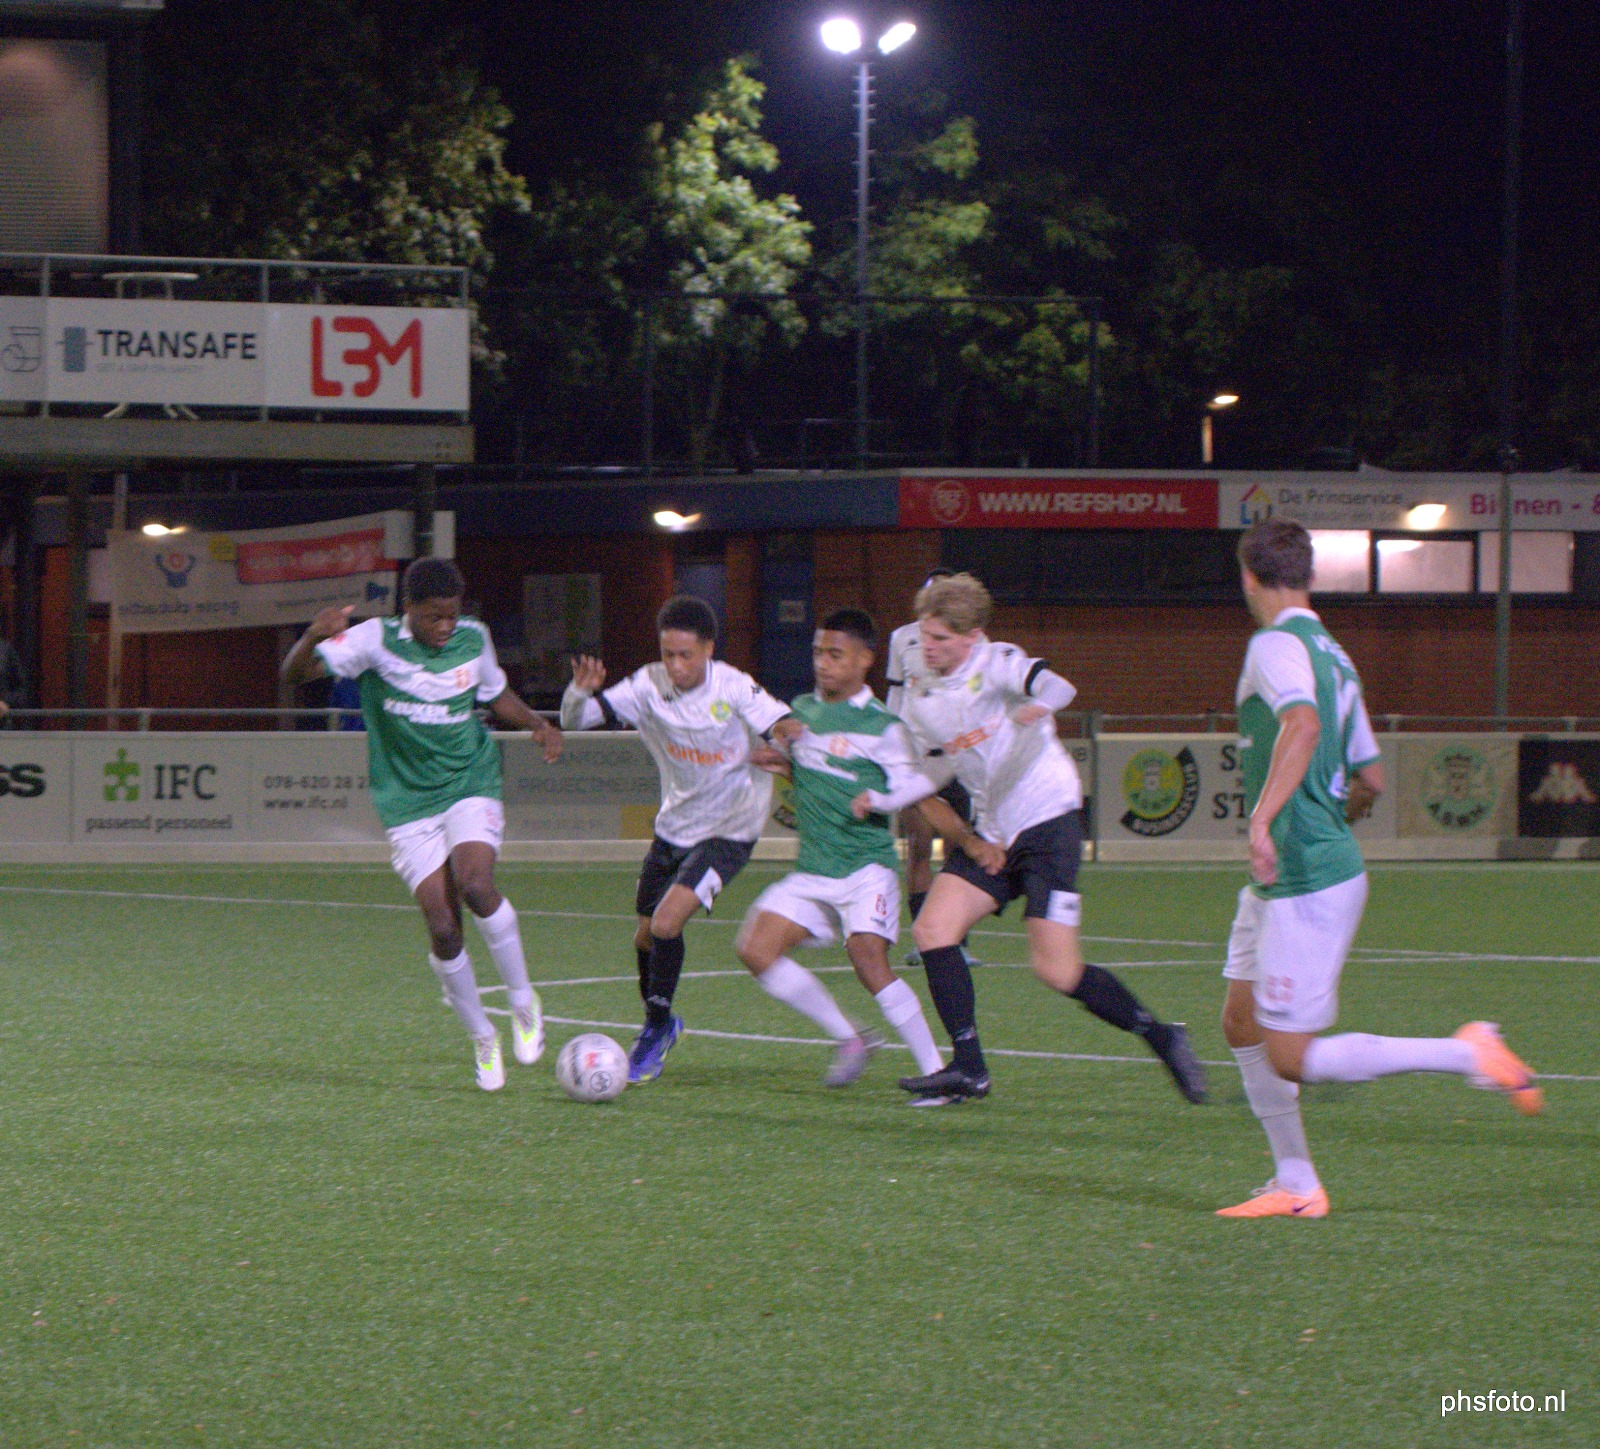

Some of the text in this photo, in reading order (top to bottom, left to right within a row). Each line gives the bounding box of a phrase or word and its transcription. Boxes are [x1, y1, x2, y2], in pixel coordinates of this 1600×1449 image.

[96, 329, 257, 360] TRANSAFE
[978, 491, 1188, 513] WWW.REFSHOP.NL
[1471, 494, 1562, 515] Binen
[154, 763, 216, 800] IFC
[86, 814, 233, 833] passend personeel
